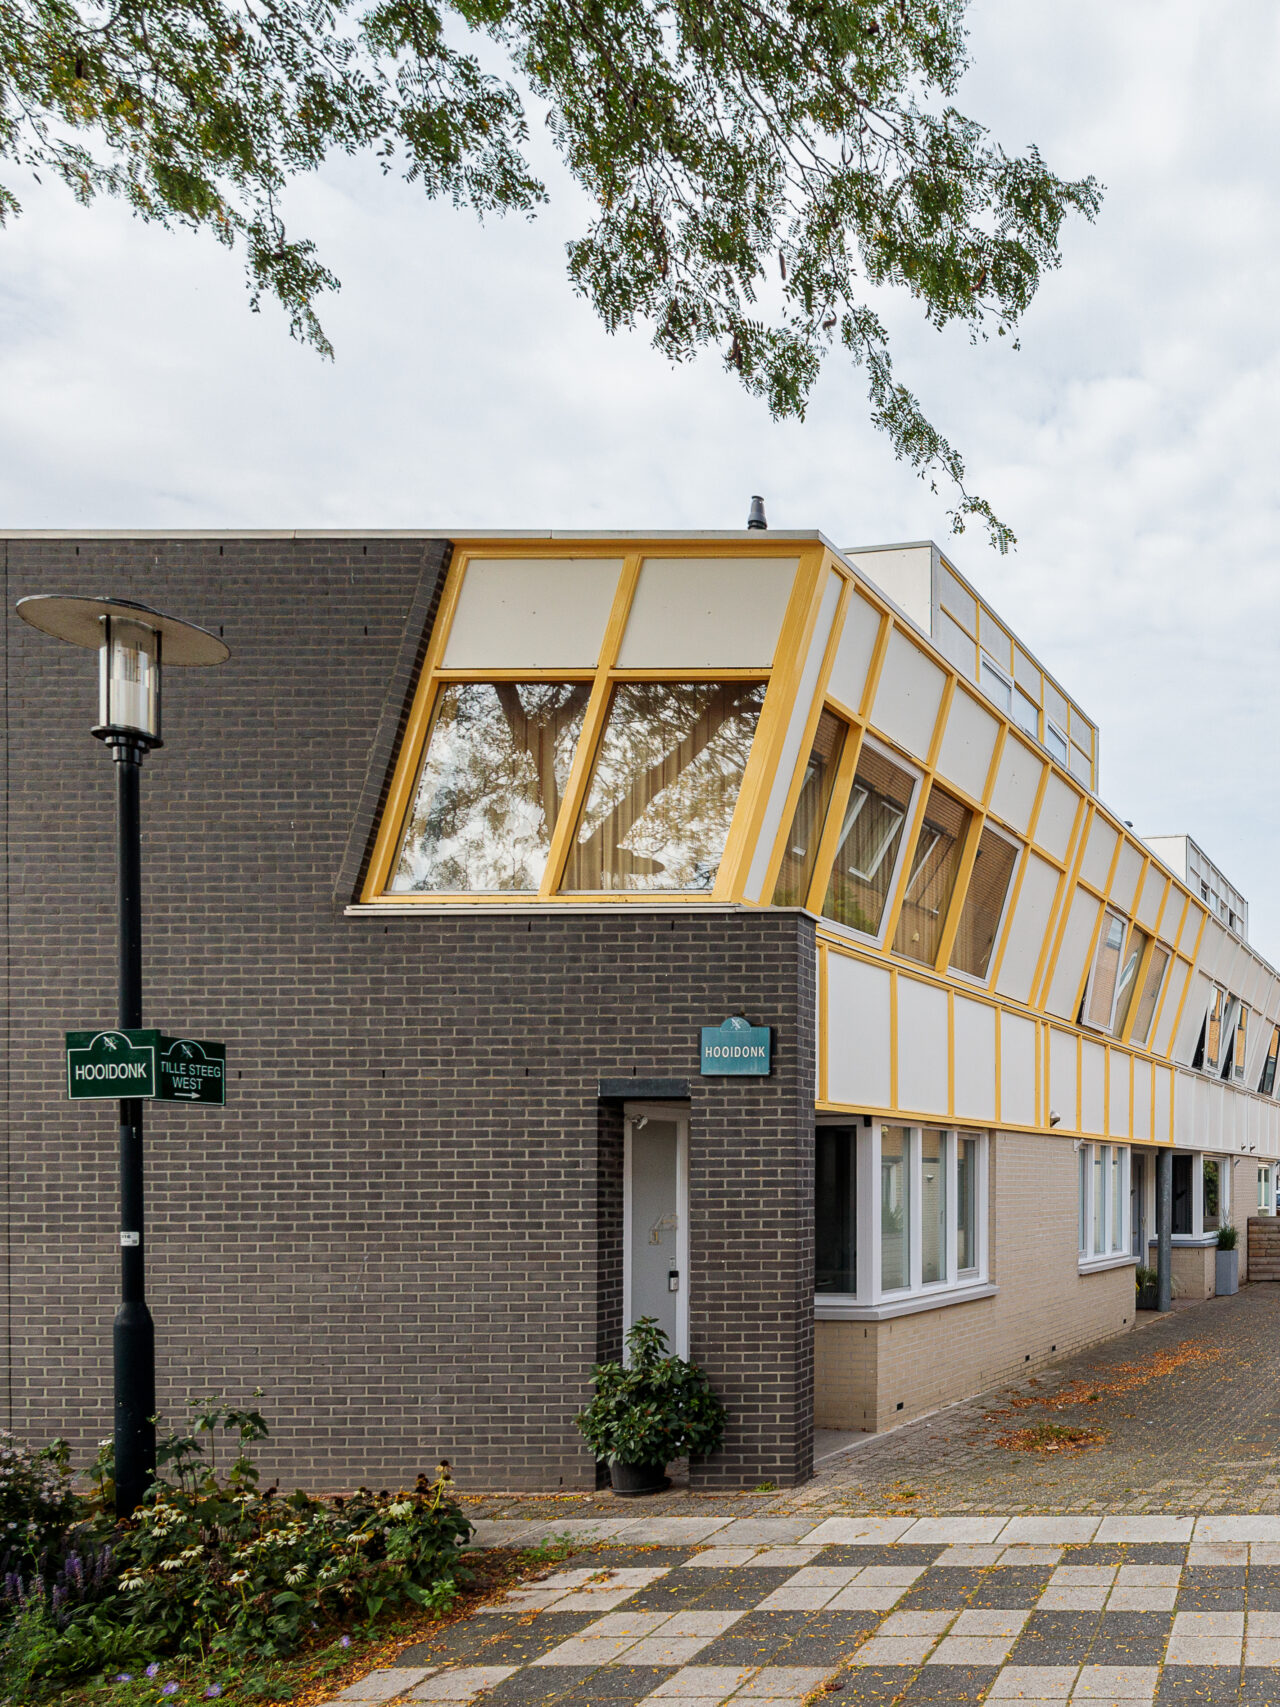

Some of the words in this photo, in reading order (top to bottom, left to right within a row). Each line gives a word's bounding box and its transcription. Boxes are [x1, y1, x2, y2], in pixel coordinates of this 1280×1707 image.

[705, 1046, 765, 1058] HOOIDONK
[75, 1063, 147, 1080] HOOIDONK
[161, 1061, 186, 1075] TILLE
[188, 1064, 221, 1078] STEEG
[172, 1076, 203, 1090] WEST
